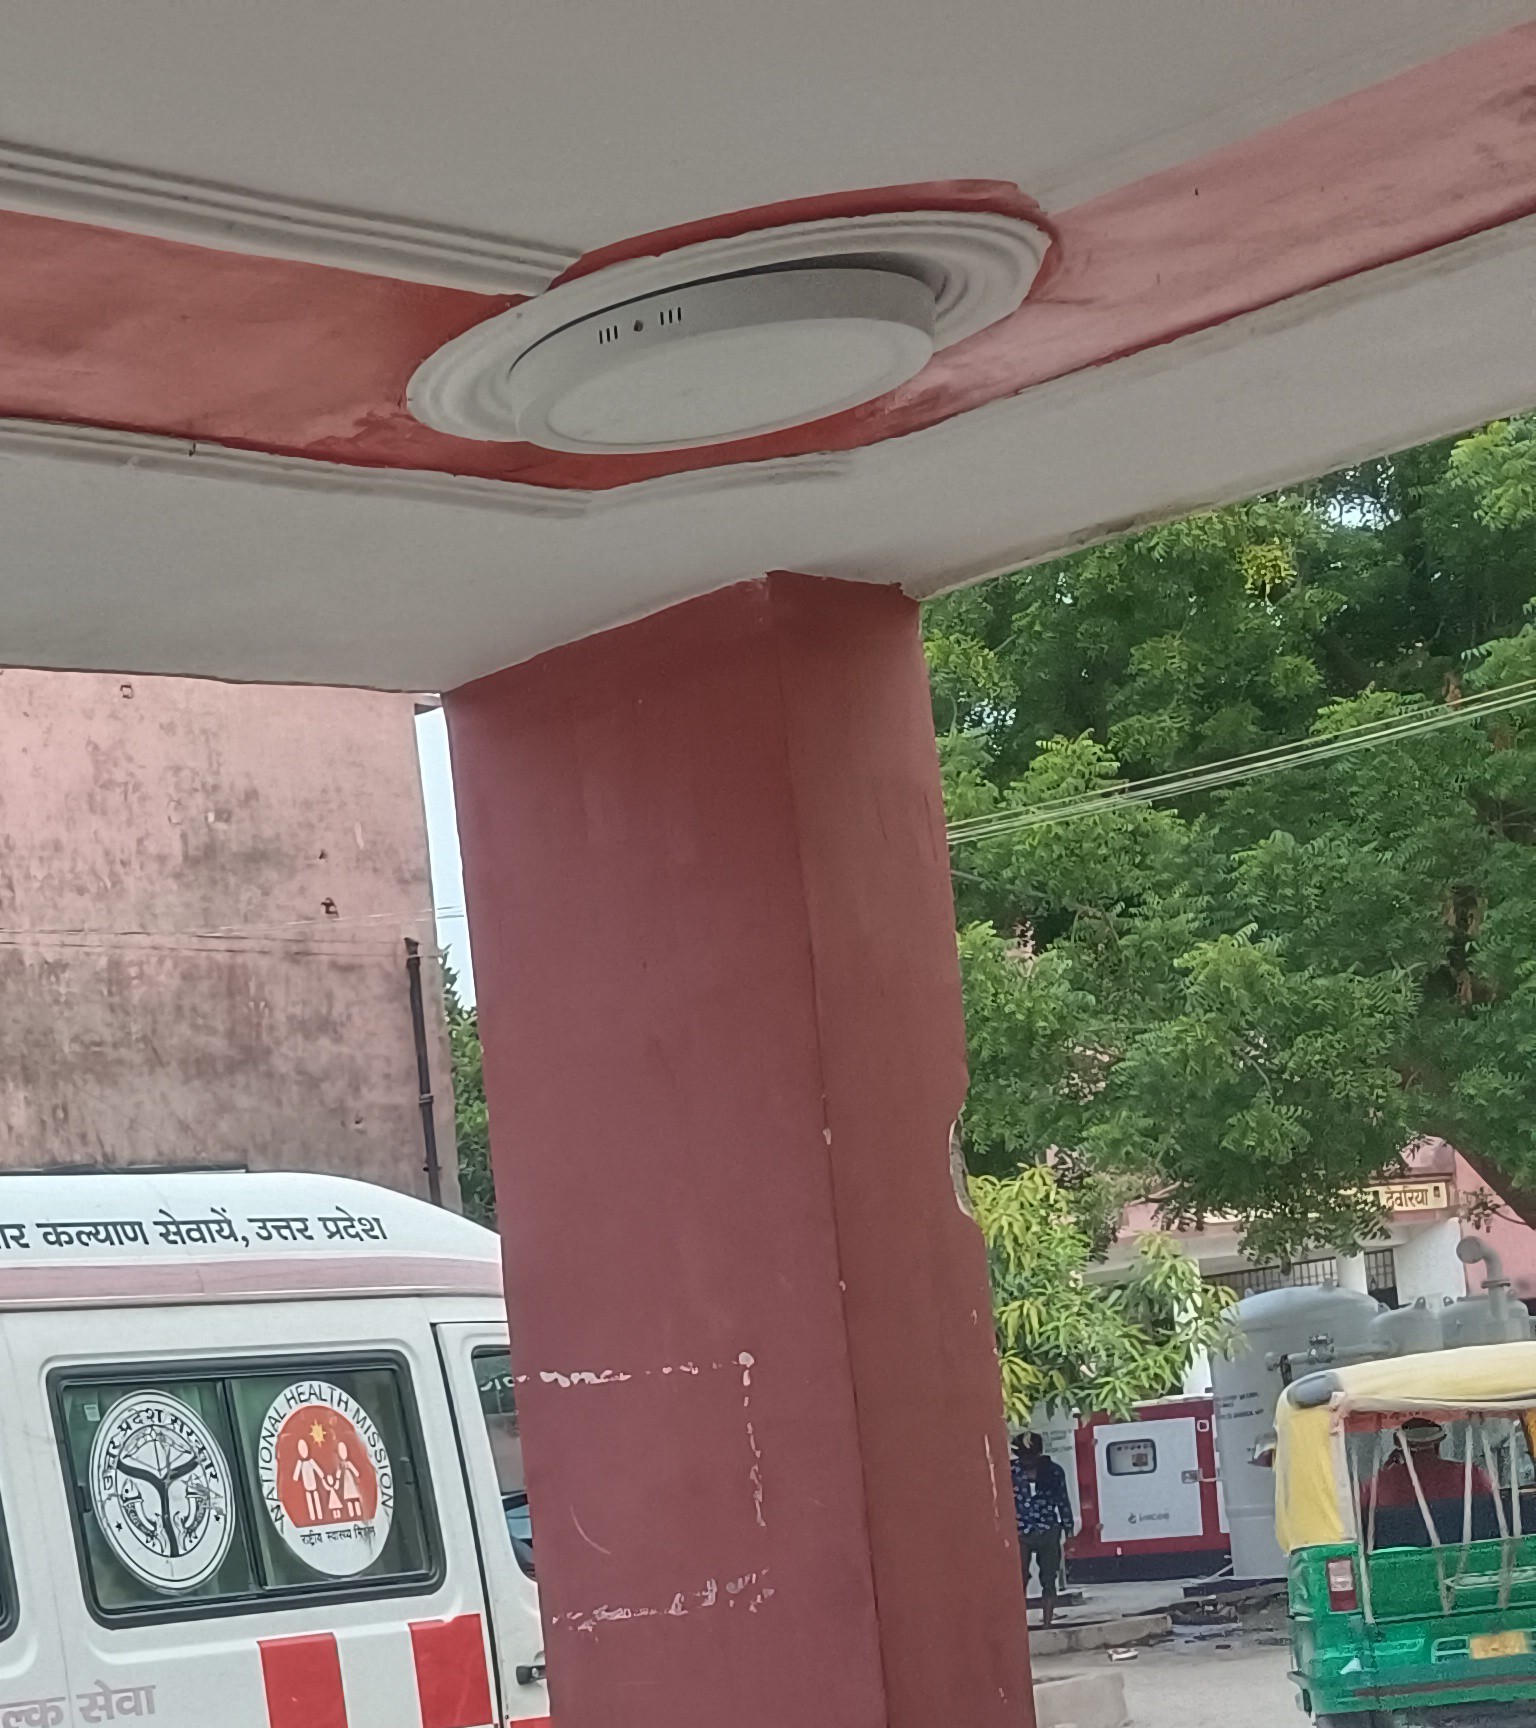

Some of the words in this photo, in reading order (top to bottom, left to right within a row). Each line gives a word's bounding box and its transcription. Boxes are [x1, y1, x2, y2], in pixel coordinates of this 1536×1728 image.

[36, 1218, 149, 1248] कल्याण
[152, 1207, 250, 1248] सेवायें,
[247, 1216, 314, 1242] उत्तर
[317, 1206, 388, 1241] प्रदेश
[259, 1405, 288, 1522] NATIONAL
[284, 1383, 350, 1413] HEALTH
[351, 1407, 394, 1510] MISSION
[76, 1679, 157, 1724] सेवा
